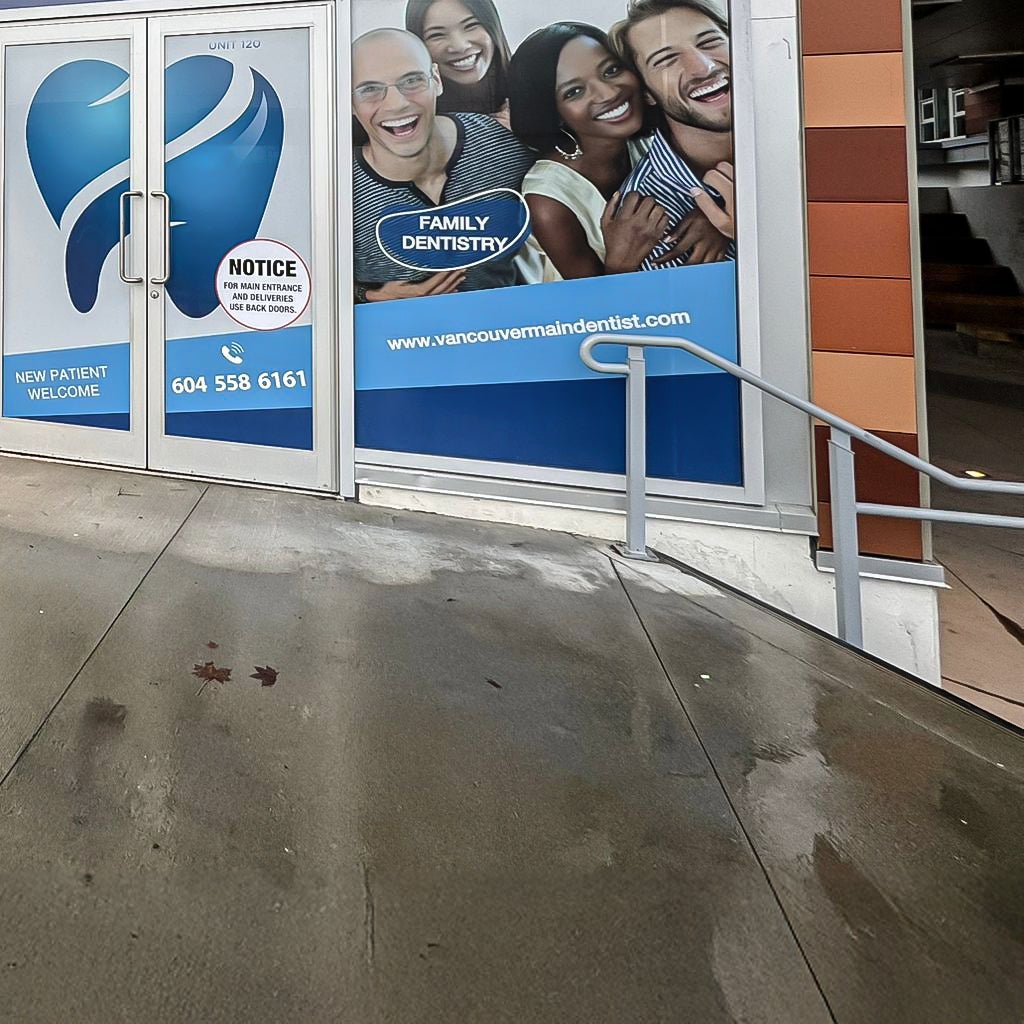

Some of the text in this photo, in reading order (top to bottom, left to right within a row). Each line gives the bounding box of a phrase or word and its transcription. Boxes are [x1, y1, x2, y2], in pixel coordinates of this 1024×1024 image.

[208, 39, 261, 50] UNIT 120
[419, 215, 490, 232] FAMILY
[402, 235, 509, 252] DENTISTRY
[229, 258, 297, 277] NOTICE
[223, 281, 303, 292] FOR MAIN ENTRANCE
[232, 292, 294, 303] AND DELIVERIES
[229, 303, 298, 314] USE BACK DOORS.
[386, 310, 691, 351] www.vancouvermaindentist.com
[15, 365, 108, 385] NEW PATIENT
[171, 370, 308, 395] 604 558 6161
[27, 384, 101, 401] WELCOME
